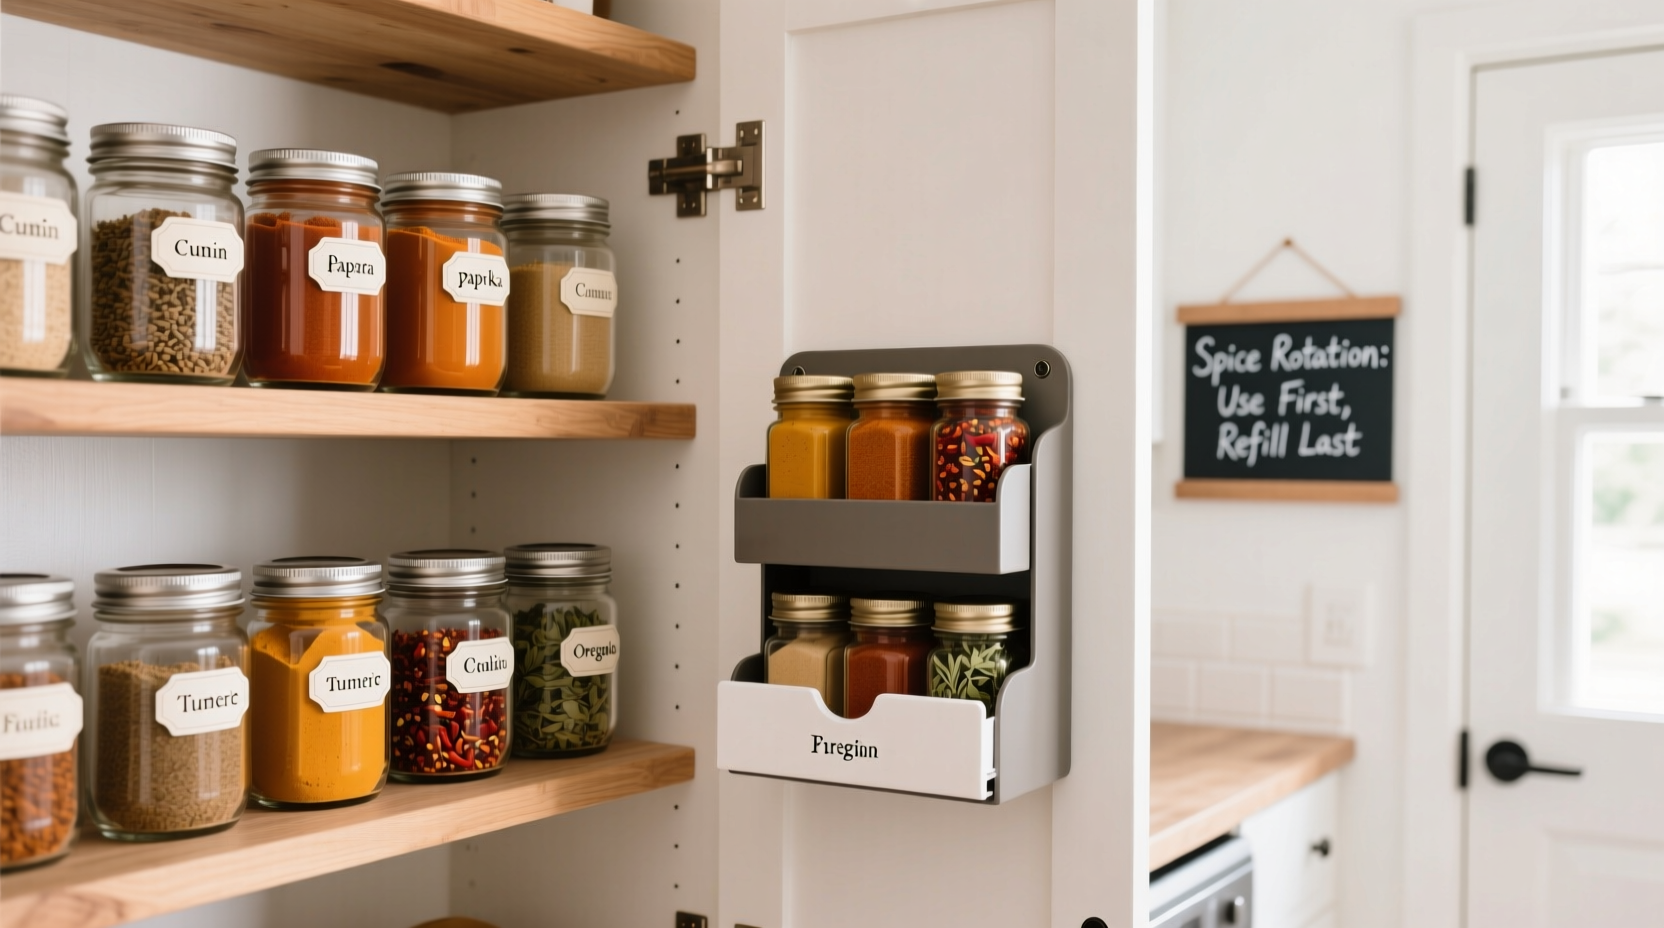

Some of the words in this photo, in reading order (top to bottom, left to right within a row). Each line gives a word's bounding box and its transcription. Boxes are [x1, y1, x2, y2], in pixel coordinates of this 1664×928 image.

[174, 239, 227, 260] Cunin
[1192, 335, 1262, 387] Spice
[1270, 333, 1390, 371] Rotation:
[1217, 384, 1265, 418] Use
[1277, 378, 1352, 421] First,
[1216, 420, 1289, 468] Refill
[1298, 421, 1363, 457] Last
